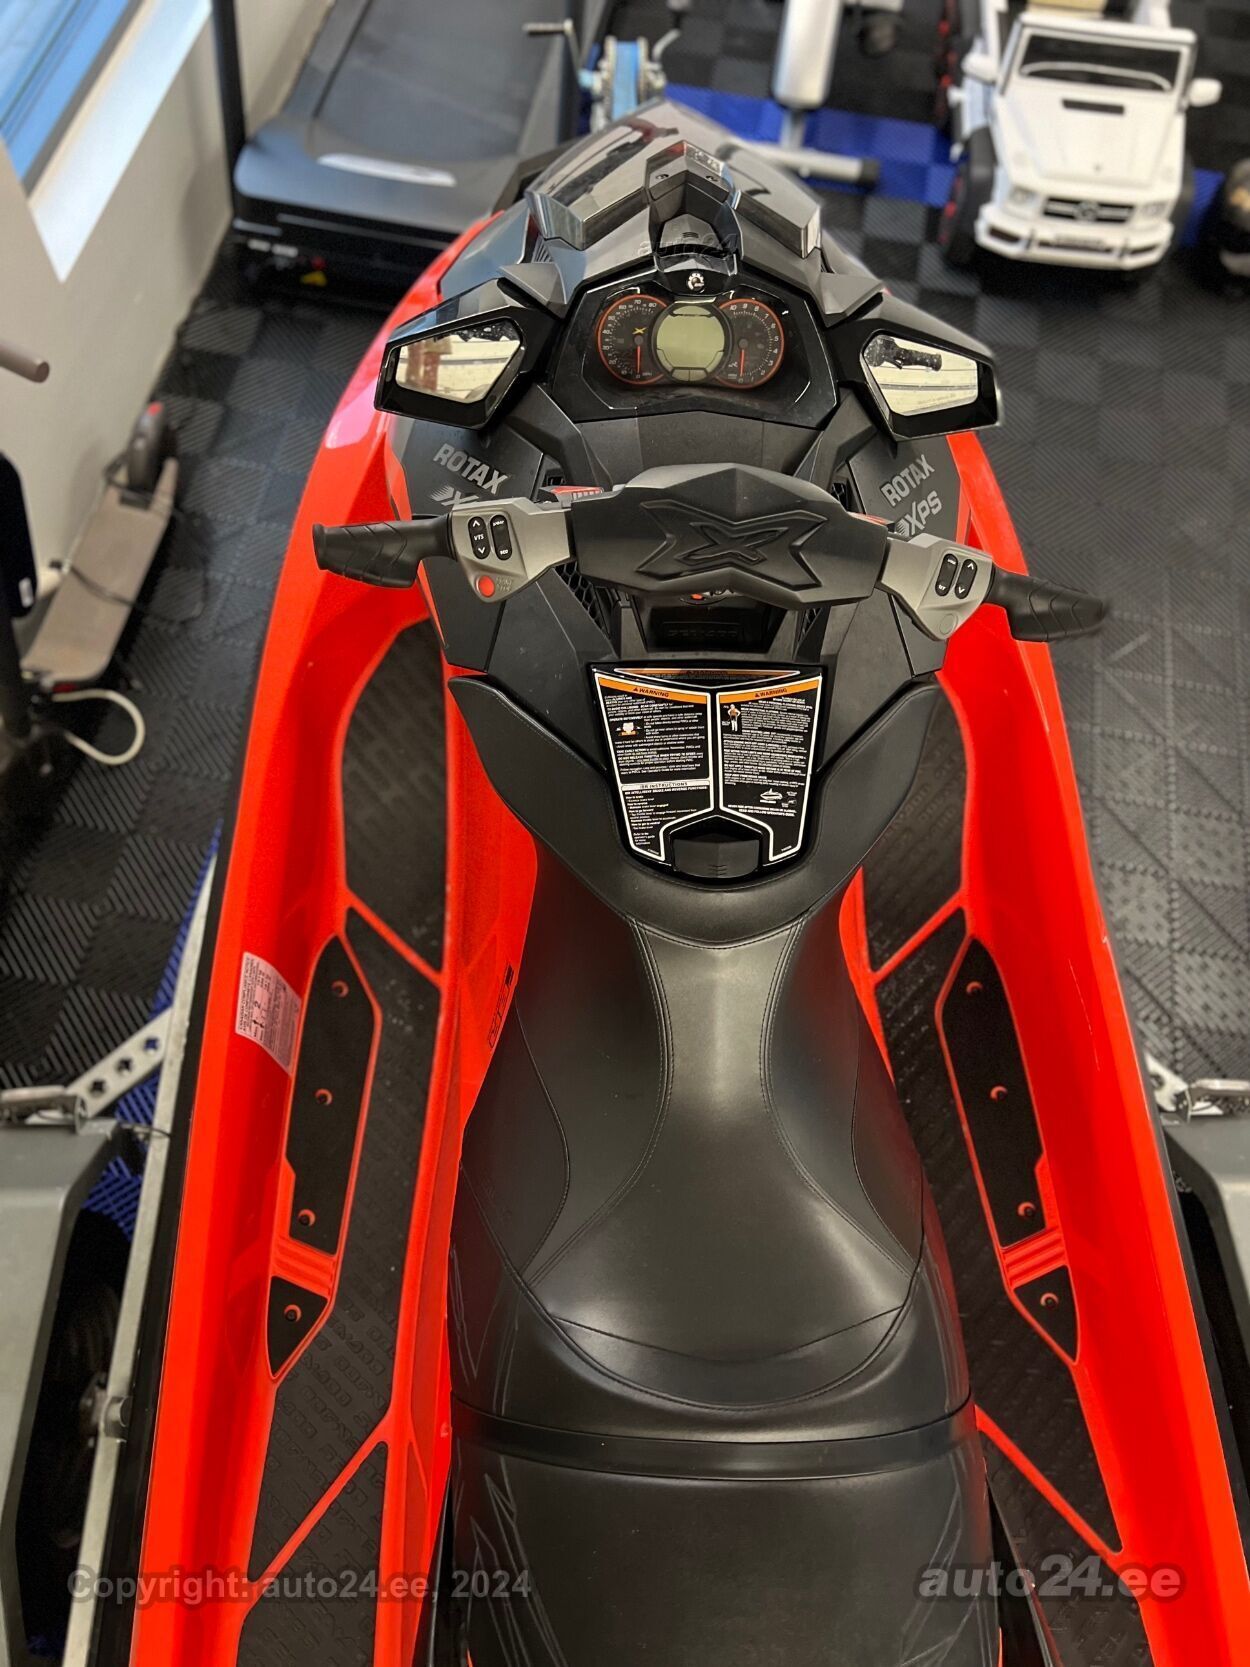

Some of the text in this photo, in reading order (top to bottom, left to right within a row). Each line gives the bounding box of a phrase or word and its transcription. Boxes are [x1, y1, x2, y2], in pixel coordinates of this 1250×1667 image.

[433, 443, 508, 495] ROTAX
[880, 454, 935, 507] ROTAX
[905, 490, 942, 536] XPS
[639, 687, 670, 698] WARNING
[760, 687, 788, 697] WARNING
